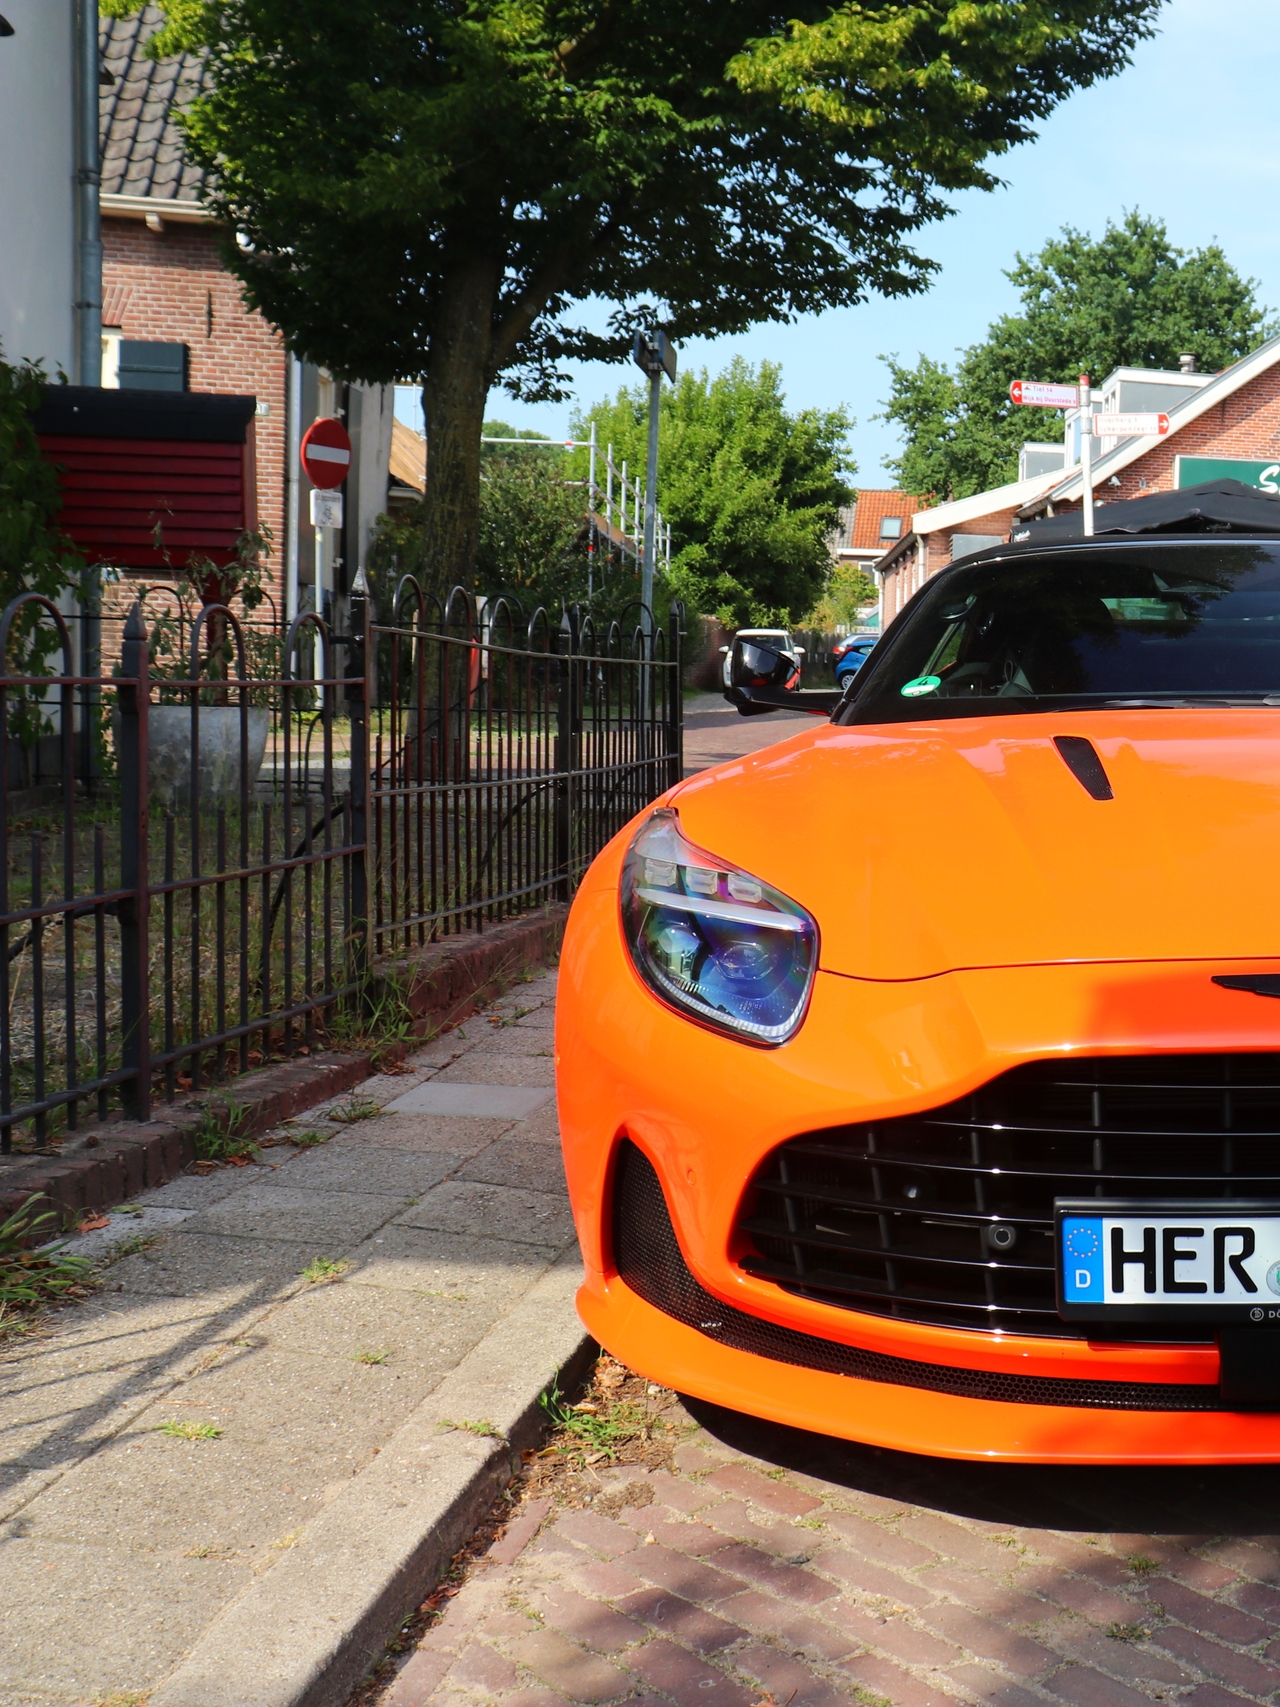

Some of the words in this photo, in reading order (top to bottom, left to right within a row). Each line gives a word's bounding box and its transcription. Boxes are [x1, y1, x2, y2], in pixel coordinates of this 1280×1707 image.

[917, 676, 929, 686] 4
[1110, 1226, 1259, 1294] HER
[1075, 1269, 1091, 1289] D
